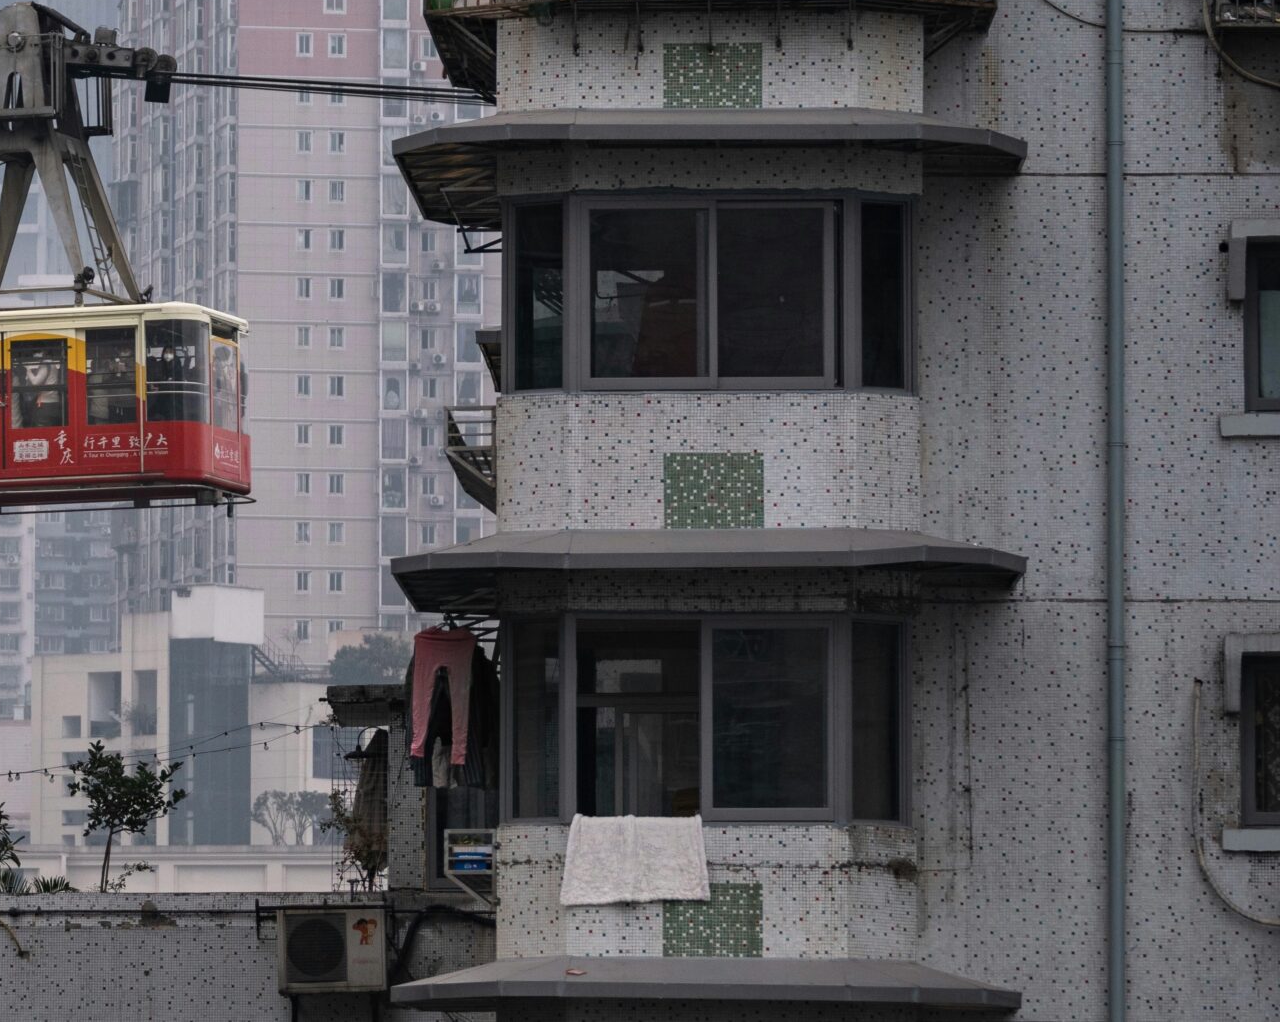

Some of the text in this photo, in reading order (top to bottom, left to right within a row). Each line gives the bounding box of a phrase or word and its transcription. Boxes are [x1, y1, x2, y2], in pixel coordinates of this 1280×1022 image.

[53, 430, 74, 465] 重庆
[84, 436, 120, 449] 行千里
